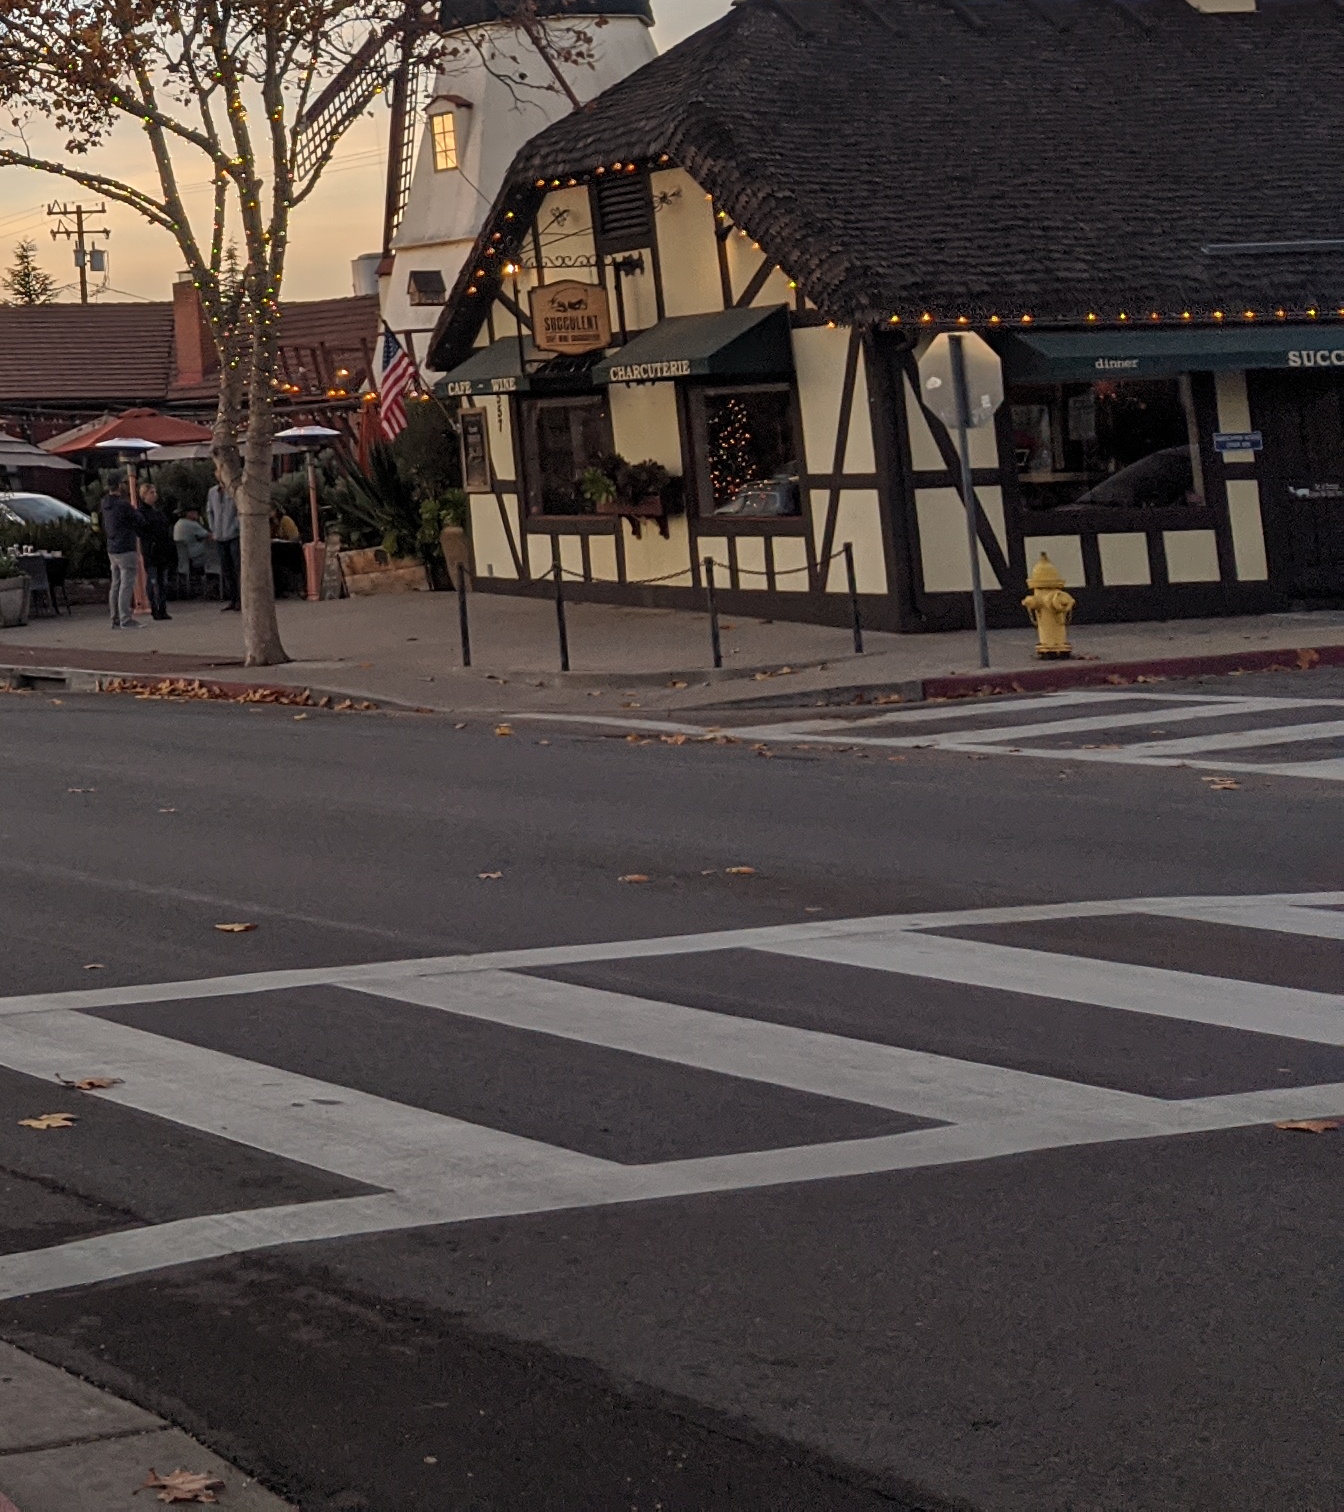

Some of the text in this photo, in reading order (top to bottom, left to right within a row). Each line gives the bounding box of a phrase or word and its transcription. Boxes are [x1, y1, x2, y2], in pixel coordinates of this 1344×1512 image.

[610, 360, 690, 382] CHARCUTERIE
[1095, 358, 1139, 369] dinner
[448, 381, 472, 396] CAFE
[491, 377, 516, 392] WINE
